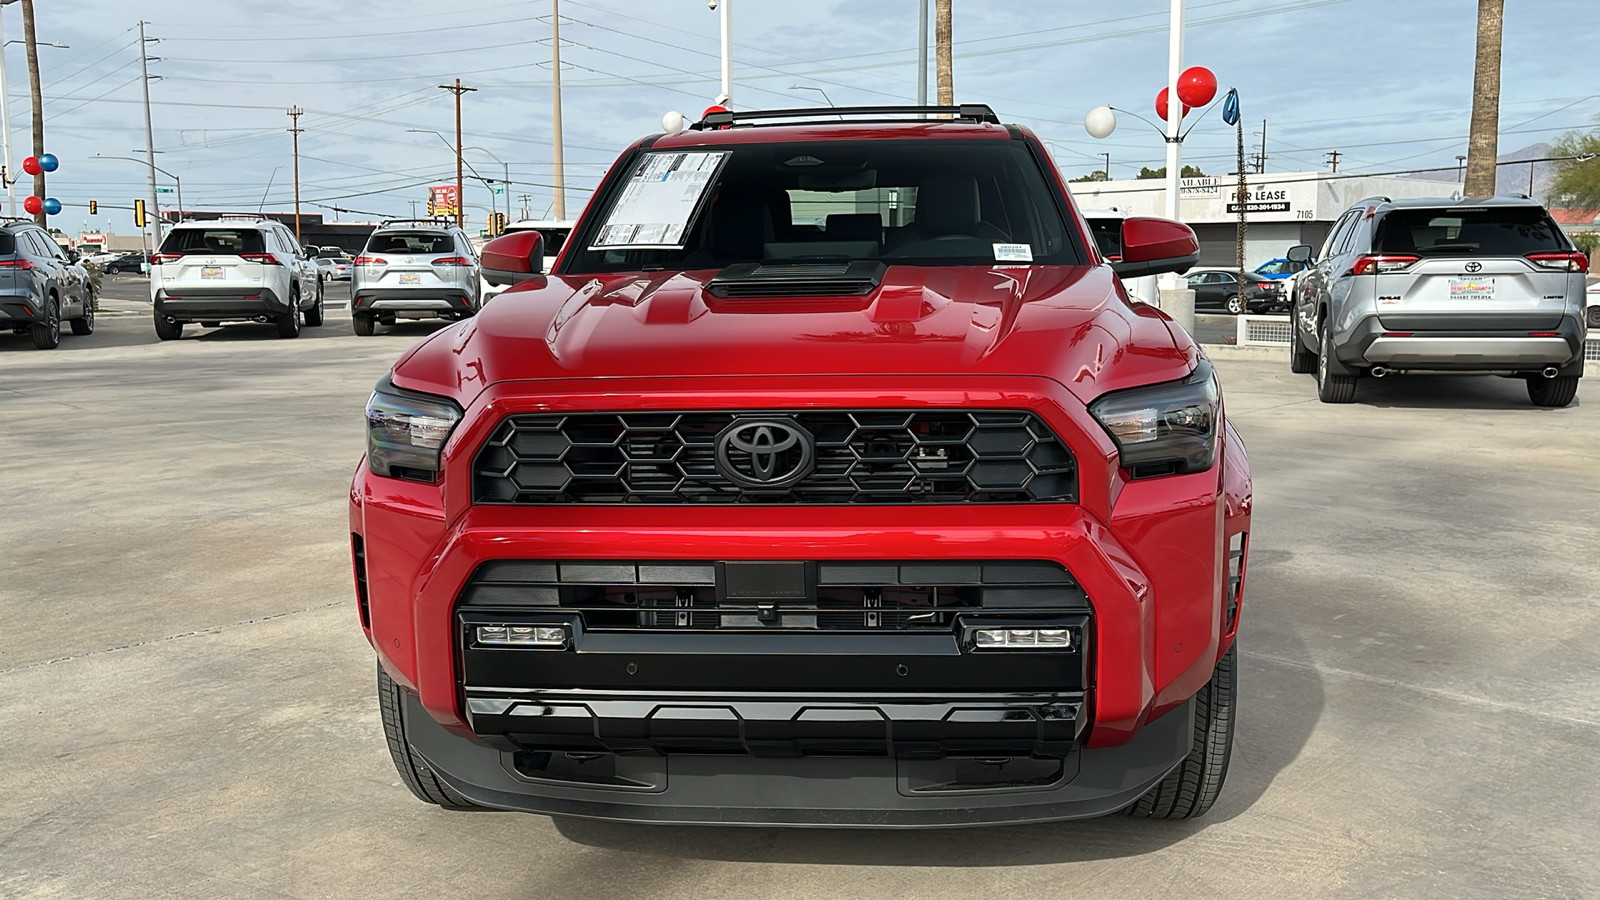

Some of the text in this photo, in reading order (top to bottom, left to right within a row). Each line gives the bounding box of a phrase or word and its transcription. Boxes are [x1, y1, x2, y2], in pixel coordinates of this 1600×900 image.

[1180, 178, 1220, 187] AILABLE
[1231, 190, 1286, 202] FR LEASE
[1296, 210, 1314, 219] 7105
